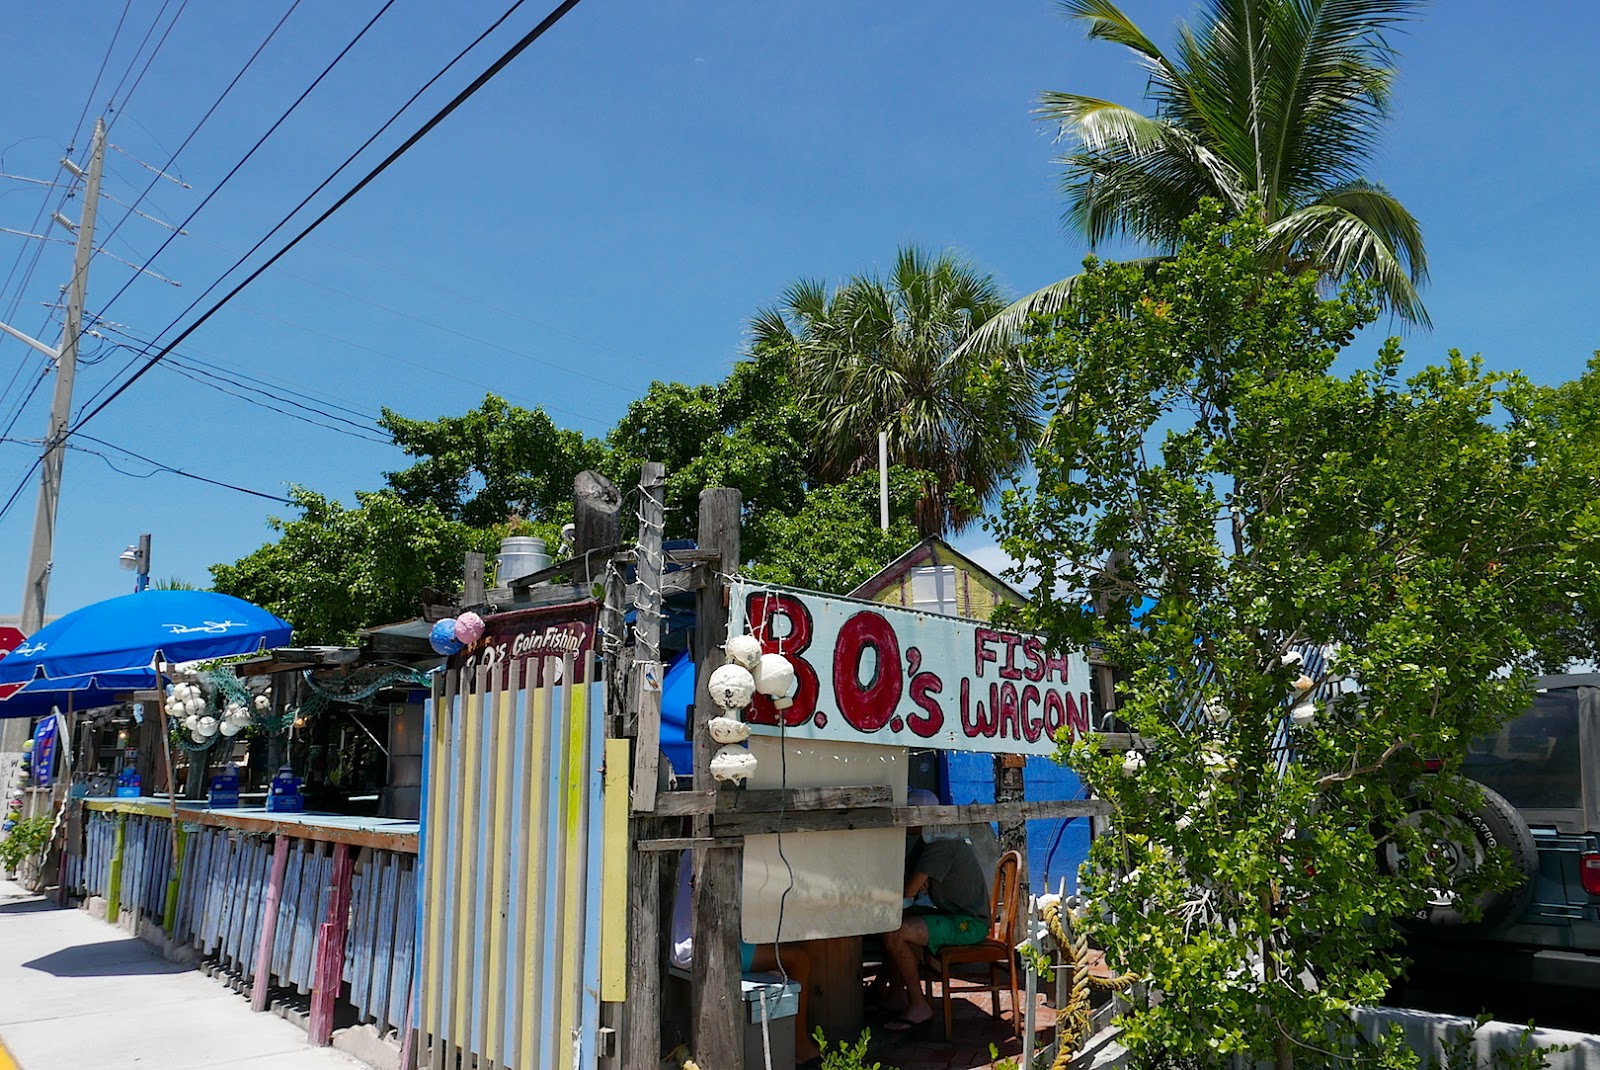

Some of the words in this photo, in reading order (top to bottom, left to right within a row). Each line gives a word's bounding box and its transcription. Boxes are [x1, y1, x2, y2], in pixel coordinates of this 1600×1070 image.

[975, 627, 1069, 685] FISH
[960, 676, 1090, 744] WAGON
[1, 759, 19, 833] WILLIA
